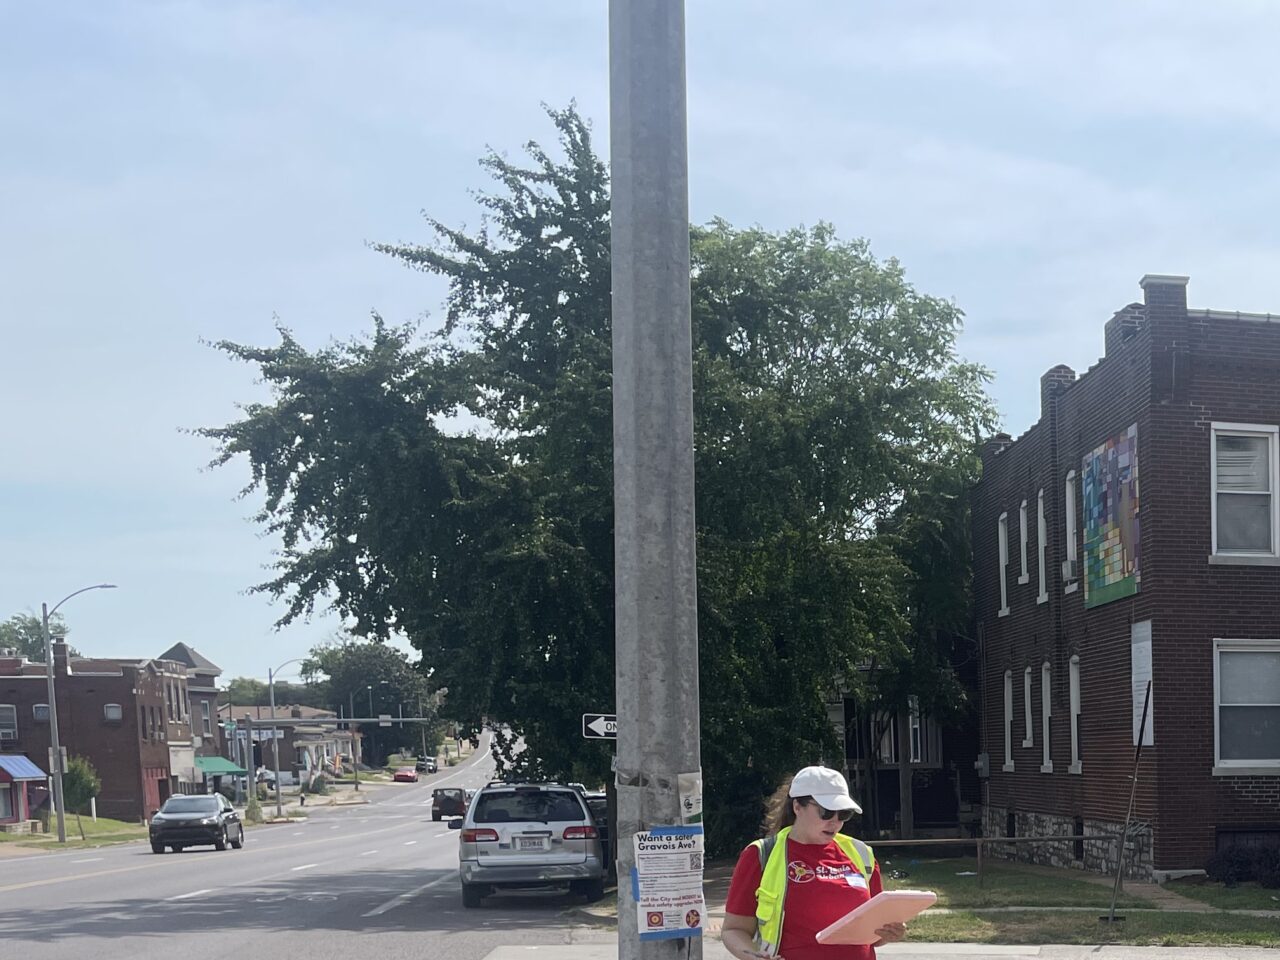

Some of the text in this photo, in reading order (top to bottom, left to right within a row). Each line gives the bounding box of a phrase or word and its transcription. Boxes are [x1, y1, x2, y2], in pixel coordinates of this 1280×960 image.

[605, 722, 617, 731] ON
[637, 834, 663, 842] Want
[638, 840, 696, 850] Gravois Ave?
